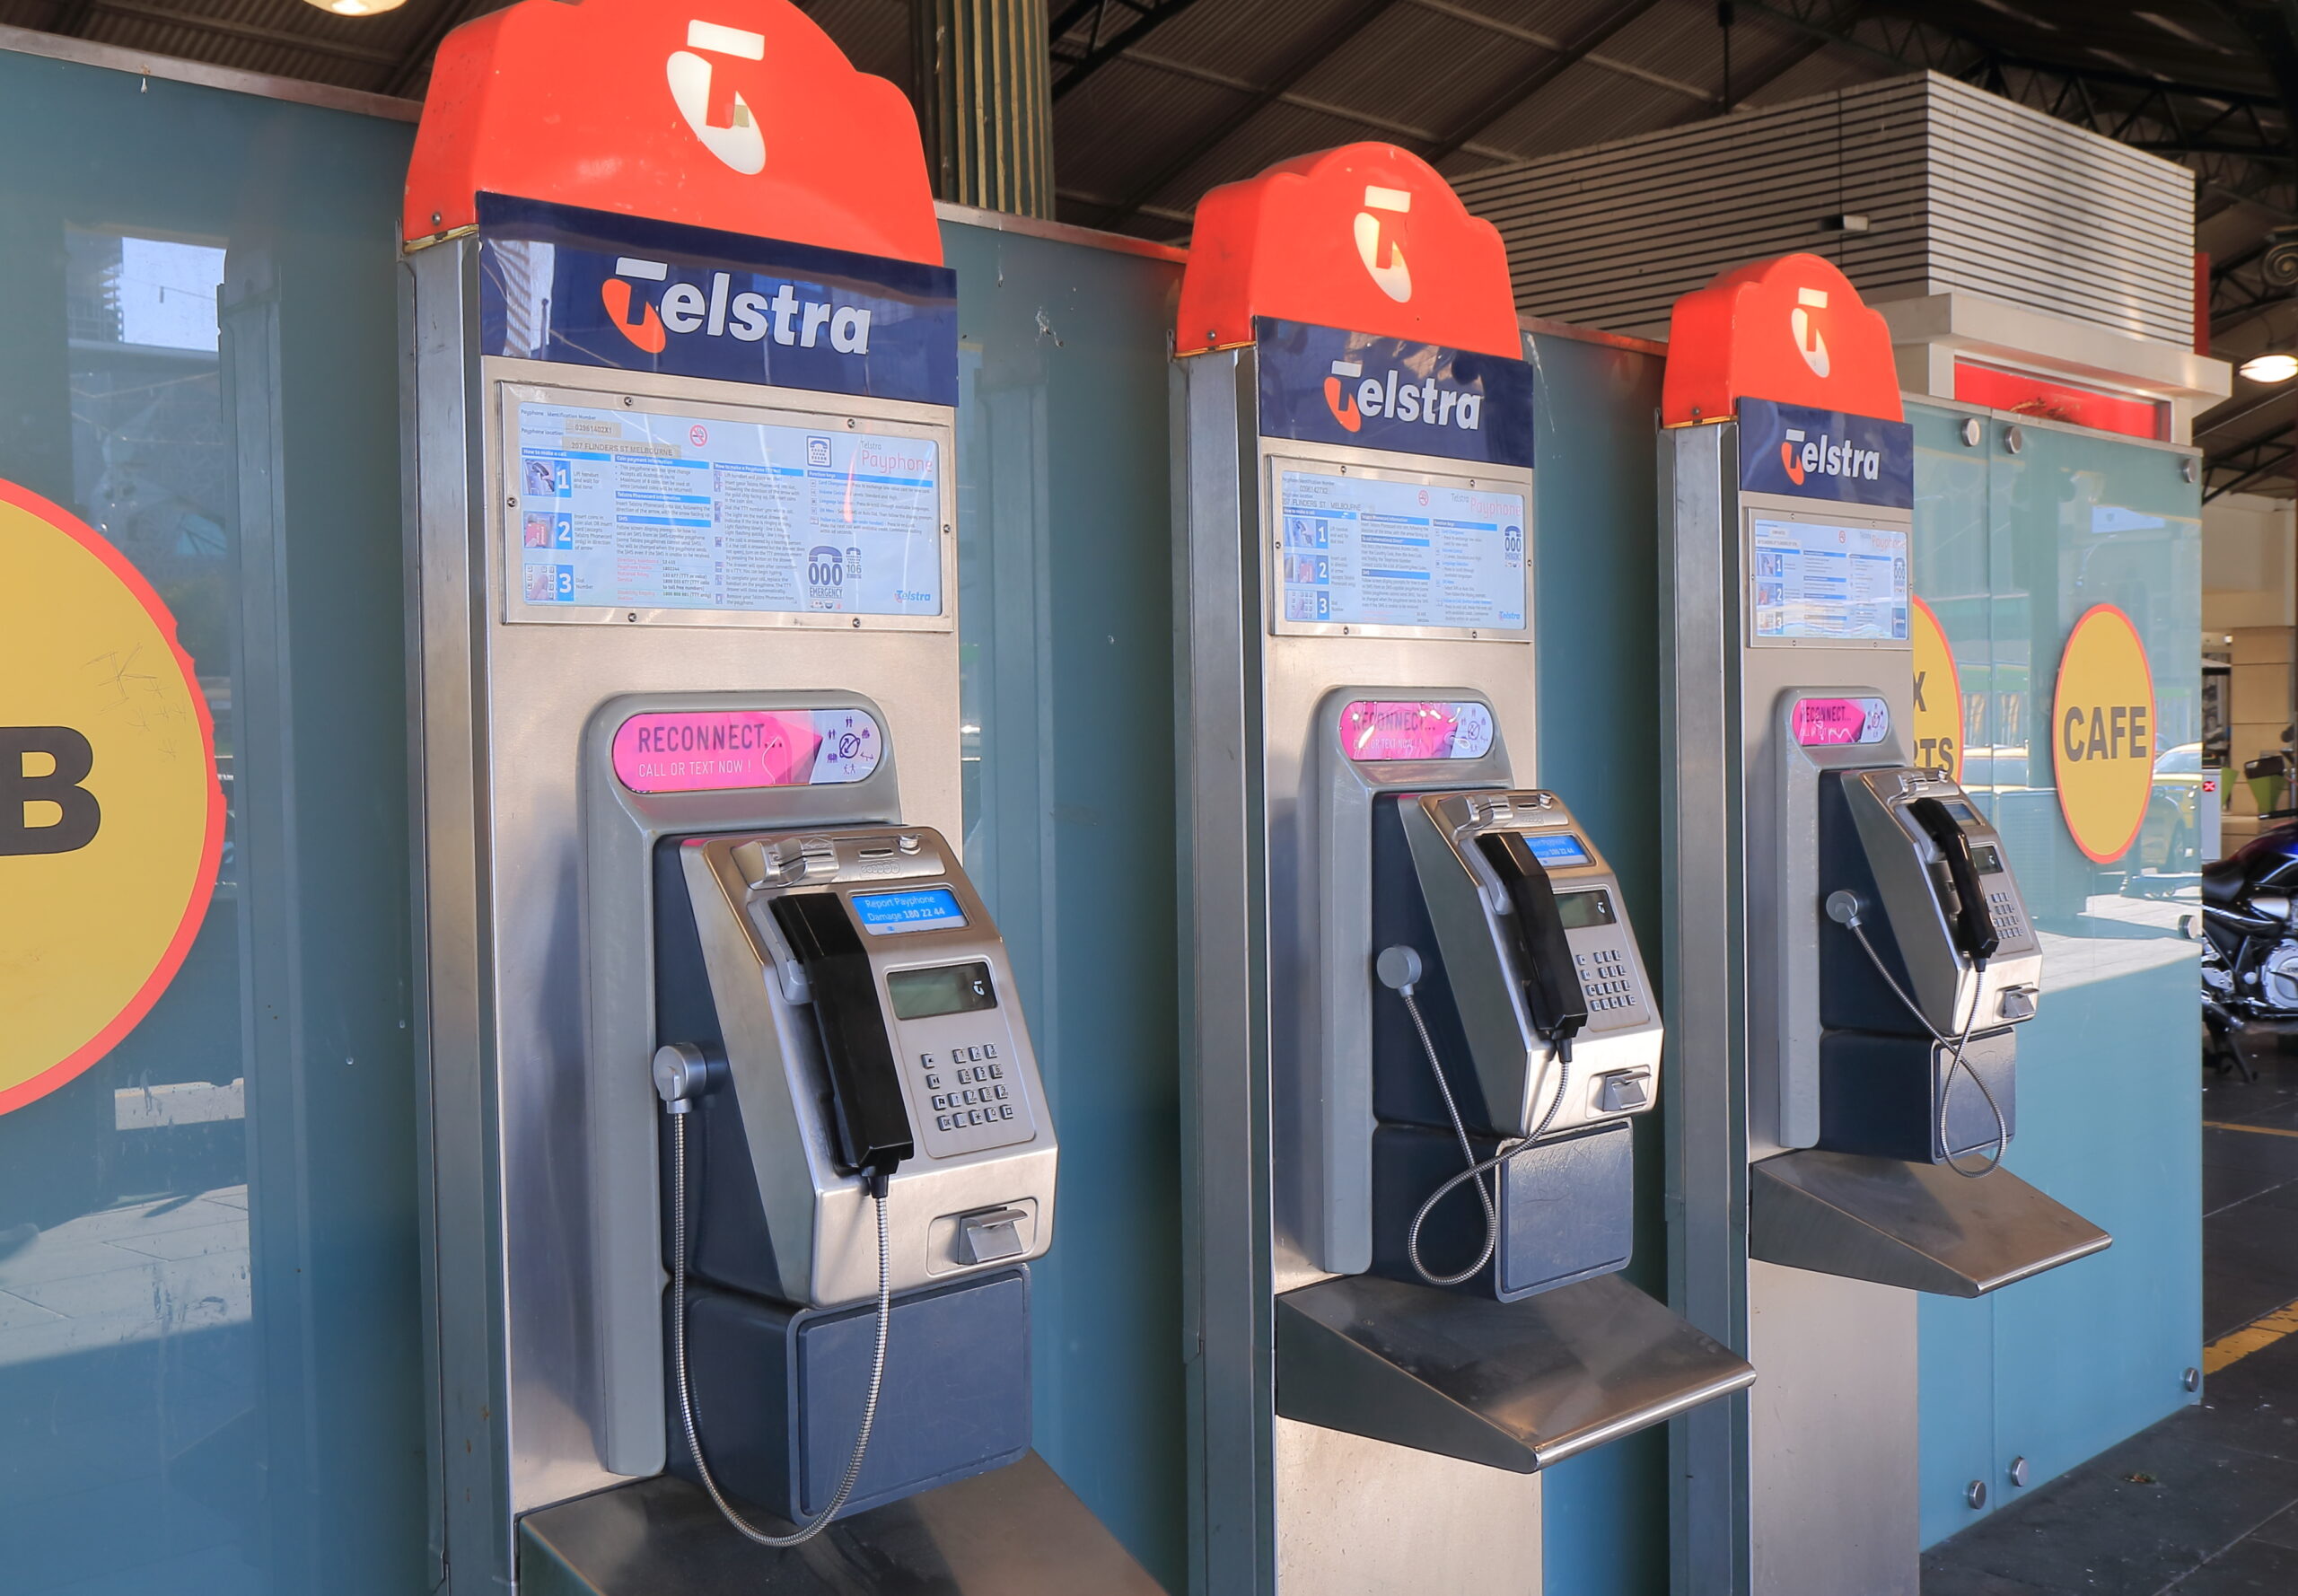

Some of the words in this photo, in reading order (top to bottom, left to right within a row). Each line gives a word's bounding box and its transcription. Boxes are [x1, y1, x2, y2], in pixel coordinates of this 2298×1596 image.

[602, 257, 871, 354] Telstra
[1324, 361, 1481, 433] Telstra
[585, 443, 618, 452] FLINDERS
[630, 446, 673, 456] MELBOURNE
[861, 441, 881, 450] Telstra
[862, 450, 933, 474] Payphone
[1781, 429, 1880, 485] Telstra
[557, 469, 569, 489] 1
[1471, 496, 1522, 519] Payphone
[558, 521, 571, 541] 2
[1319, 526, 1326, 542] 1
[1505, 537, 1522, 552] 000
[809, 563, 843, 585] 000
[846, 565, 862, 574] 106
[1319, 562, 1327, 578] 2
[559, 573, 572, 593] 3
[810, 587, 843, 598] EMERGENCY
[894, 591, 931, 603] Telstra
[1320, 598, 1327, 614] 3
[2064, 706, 2146, 761] CAFE
[638, 763, 665, 777] CALL
[671, 762, 685, 776] OR
[689, 761, 714, 775] TEXT
[718, 760, 742, 774] NOW
[865, 899, 893, 908] Report
[895, 896, 934, 908] Payphone
[867, 912, 903, 922] Damage
[903, 910, 919, 918] 180
[921, 908, 933, 917] 22
[934, 907, 945, 916] 44
